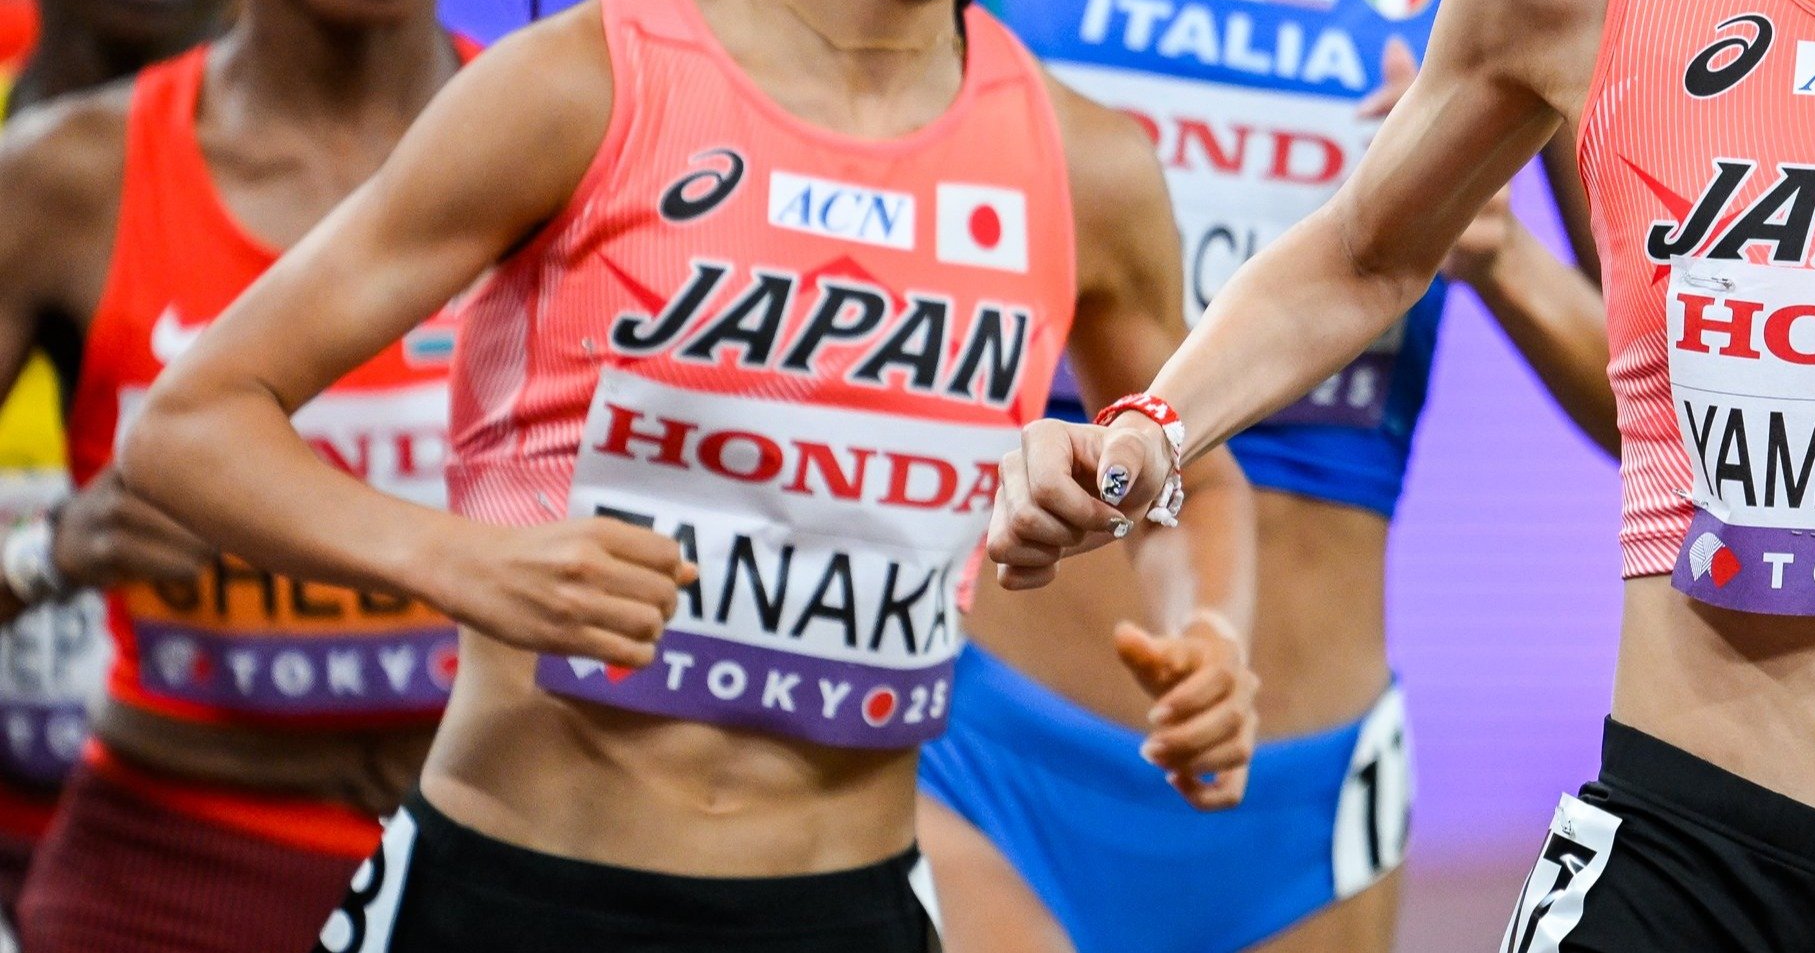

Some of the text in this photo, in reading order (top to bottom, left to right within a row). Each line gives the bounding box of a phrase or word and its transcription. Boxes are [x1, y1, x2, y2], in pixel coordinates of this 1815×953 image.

[777, 182, 908, 240] ACN
[611, 259, 1030, 405] JAPAN
[594, 402, 1000, 514] HONDA
[902, 679, 948, 725] 25
